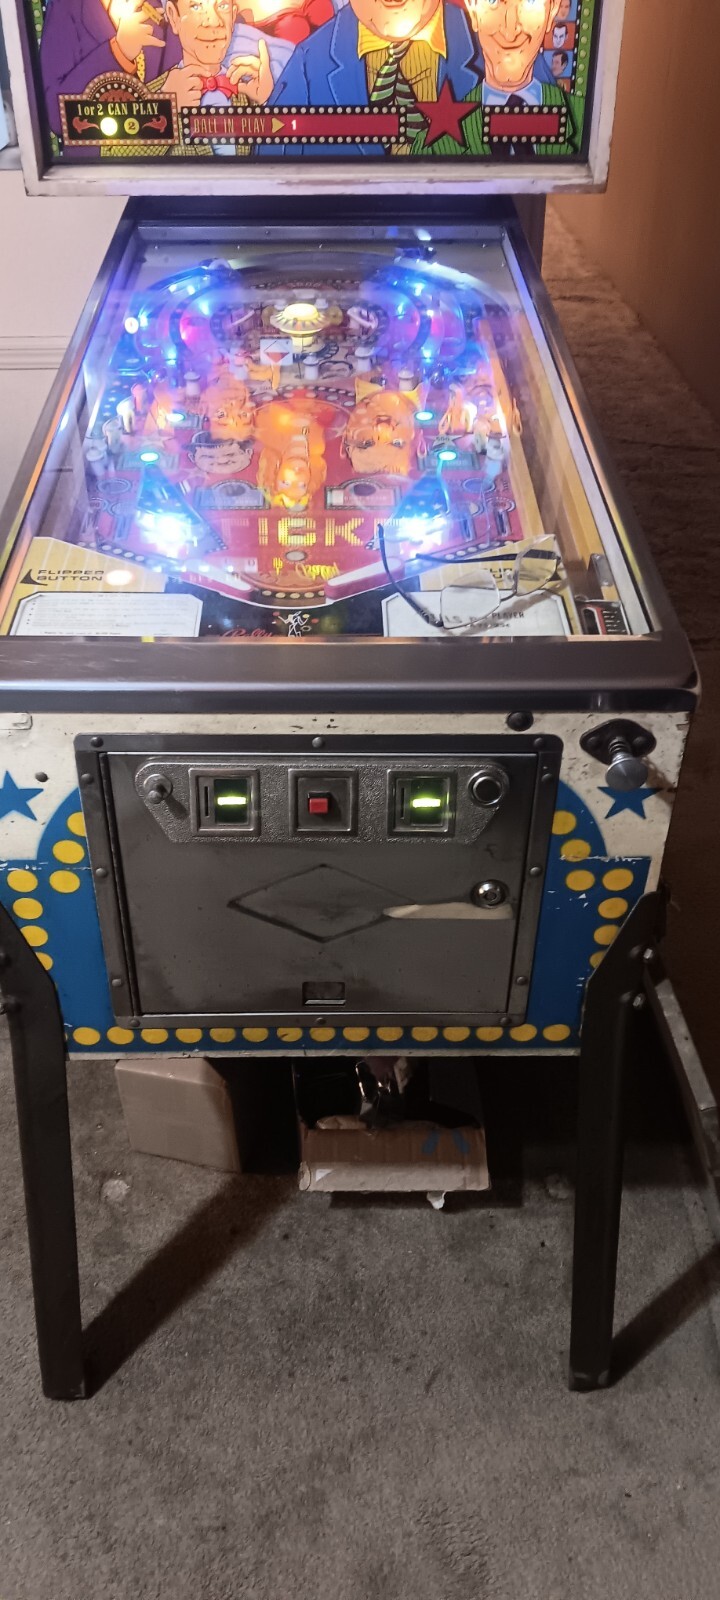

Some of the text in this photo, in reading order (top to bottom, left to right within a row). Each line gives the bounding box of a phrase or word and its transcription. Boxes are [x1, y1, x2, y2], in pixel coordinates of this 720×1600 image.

[84, 105, 95, 116] or
[96, 103, 104, 116] 2
[107, 103, 128, 116] CAN
[132, 102, 159, 115] PLAY
[193, 117, 266, 134] BALL IN PLAY
[290, 119, 297, 131] 1
